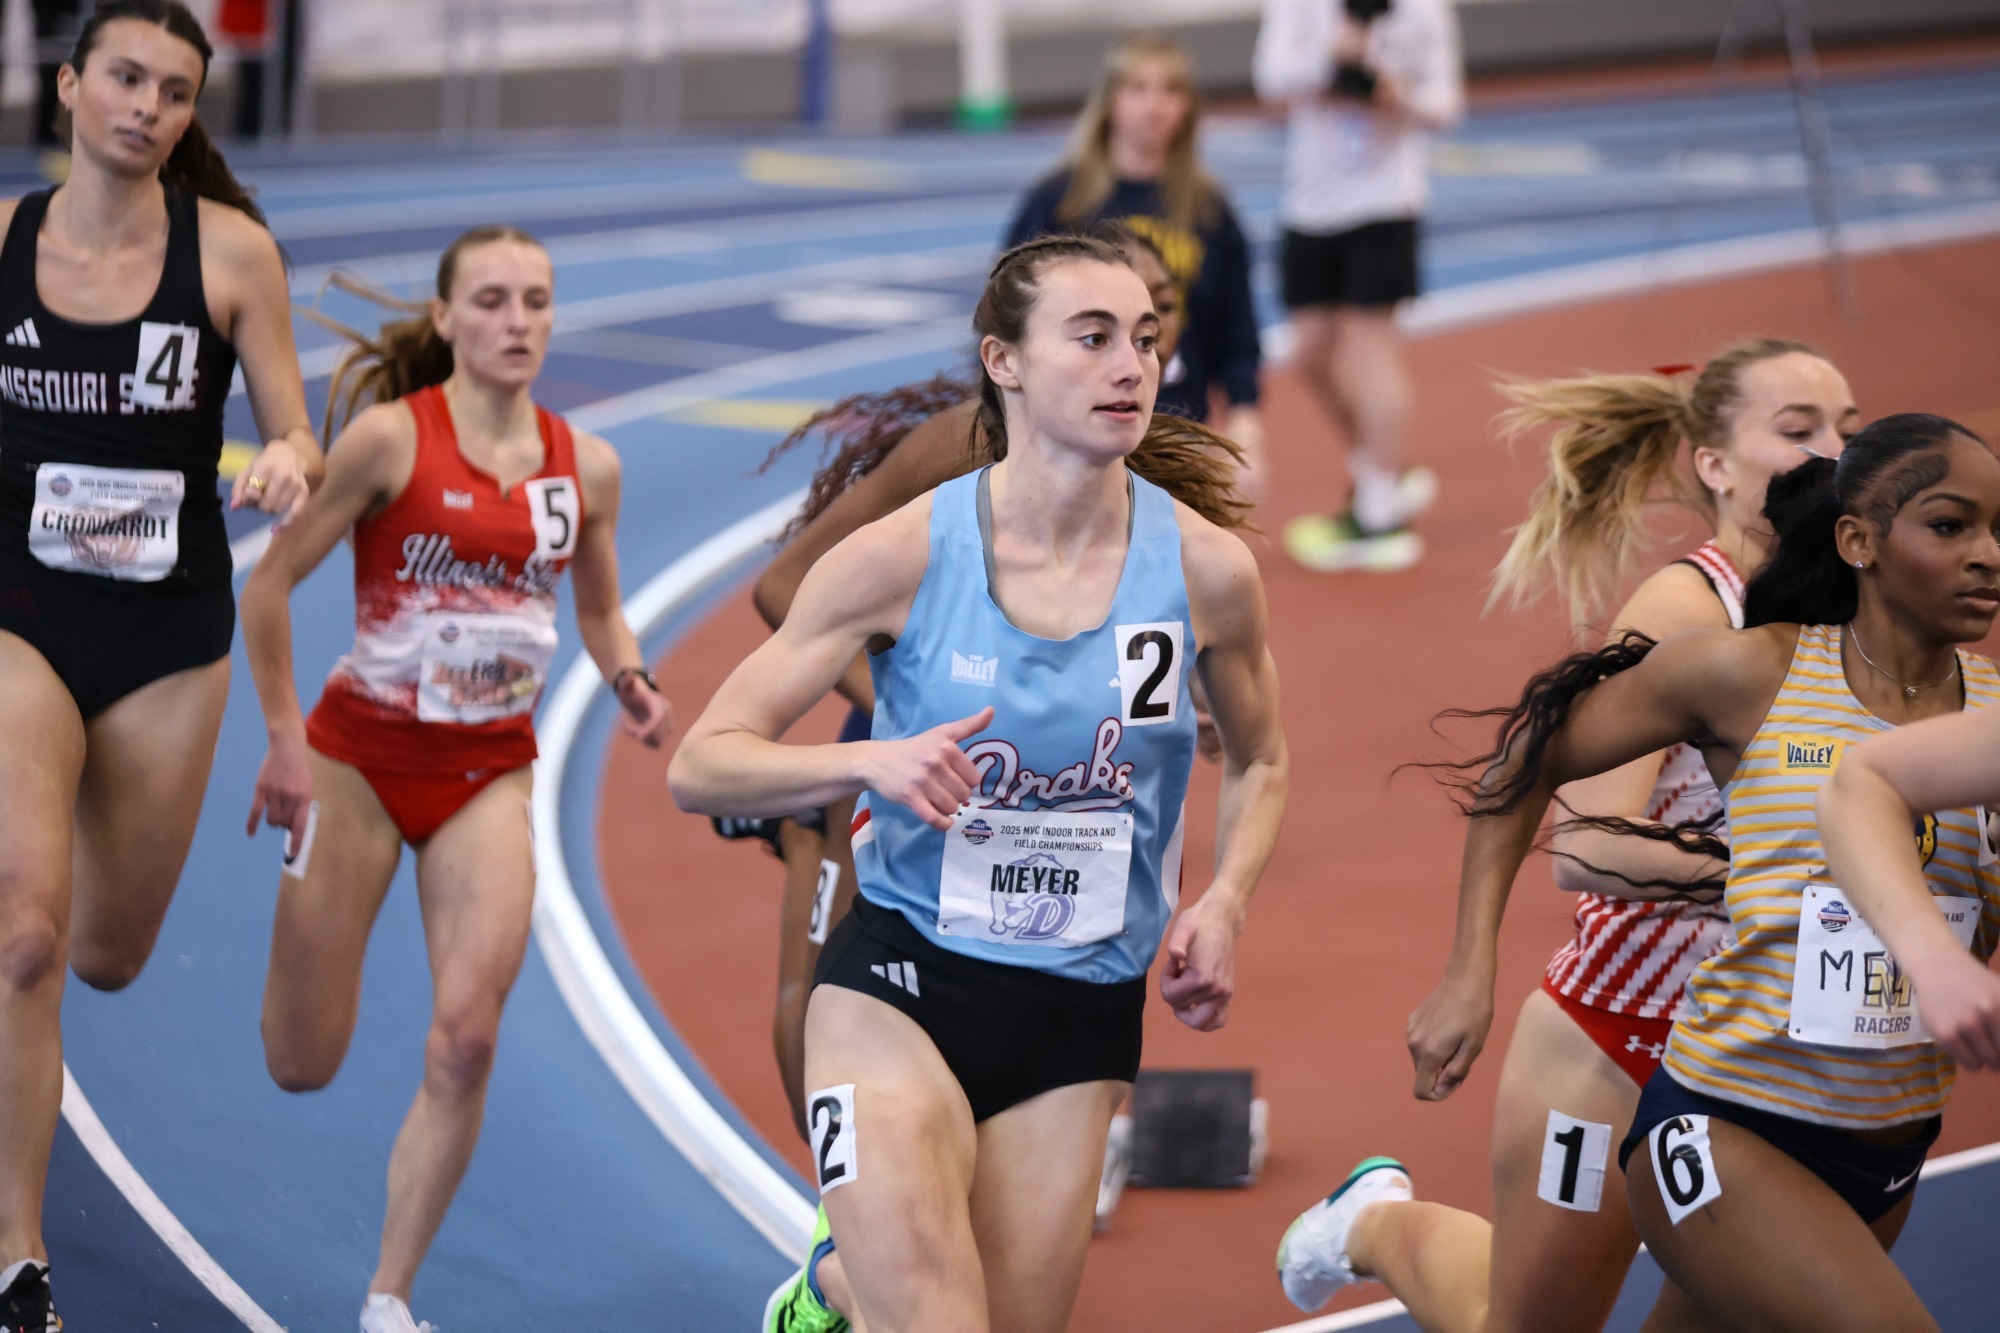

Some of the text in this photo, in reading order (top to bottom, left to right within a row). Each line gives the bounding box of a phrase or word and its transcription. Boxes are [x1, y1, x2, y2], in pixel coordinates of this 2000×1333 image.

[145, 332, 185, 404] 4
[544, 487, 569, 550] 5
[1126, 630, 1174, 719] 2
[963, 716, 1135, 811] Drake
[1787, 741, 1834, 764] VALLEY
[1000, 825, 1116, 838] 2025 MVC INDOOR TRACK AND
[1014, 839, 1103, 852] FIELD CHAMPIONSHIPS
[990, 864, 1080, 895] MEYER
[1951, 912, 1965, 922] AND
[1854, 1015, 1912, 1035] RACERS
[811, 1095, 846, 1187] 2
[1553, 1125, 1585, 1204] 1
[1657, 1116, 1705, 1207] 6
